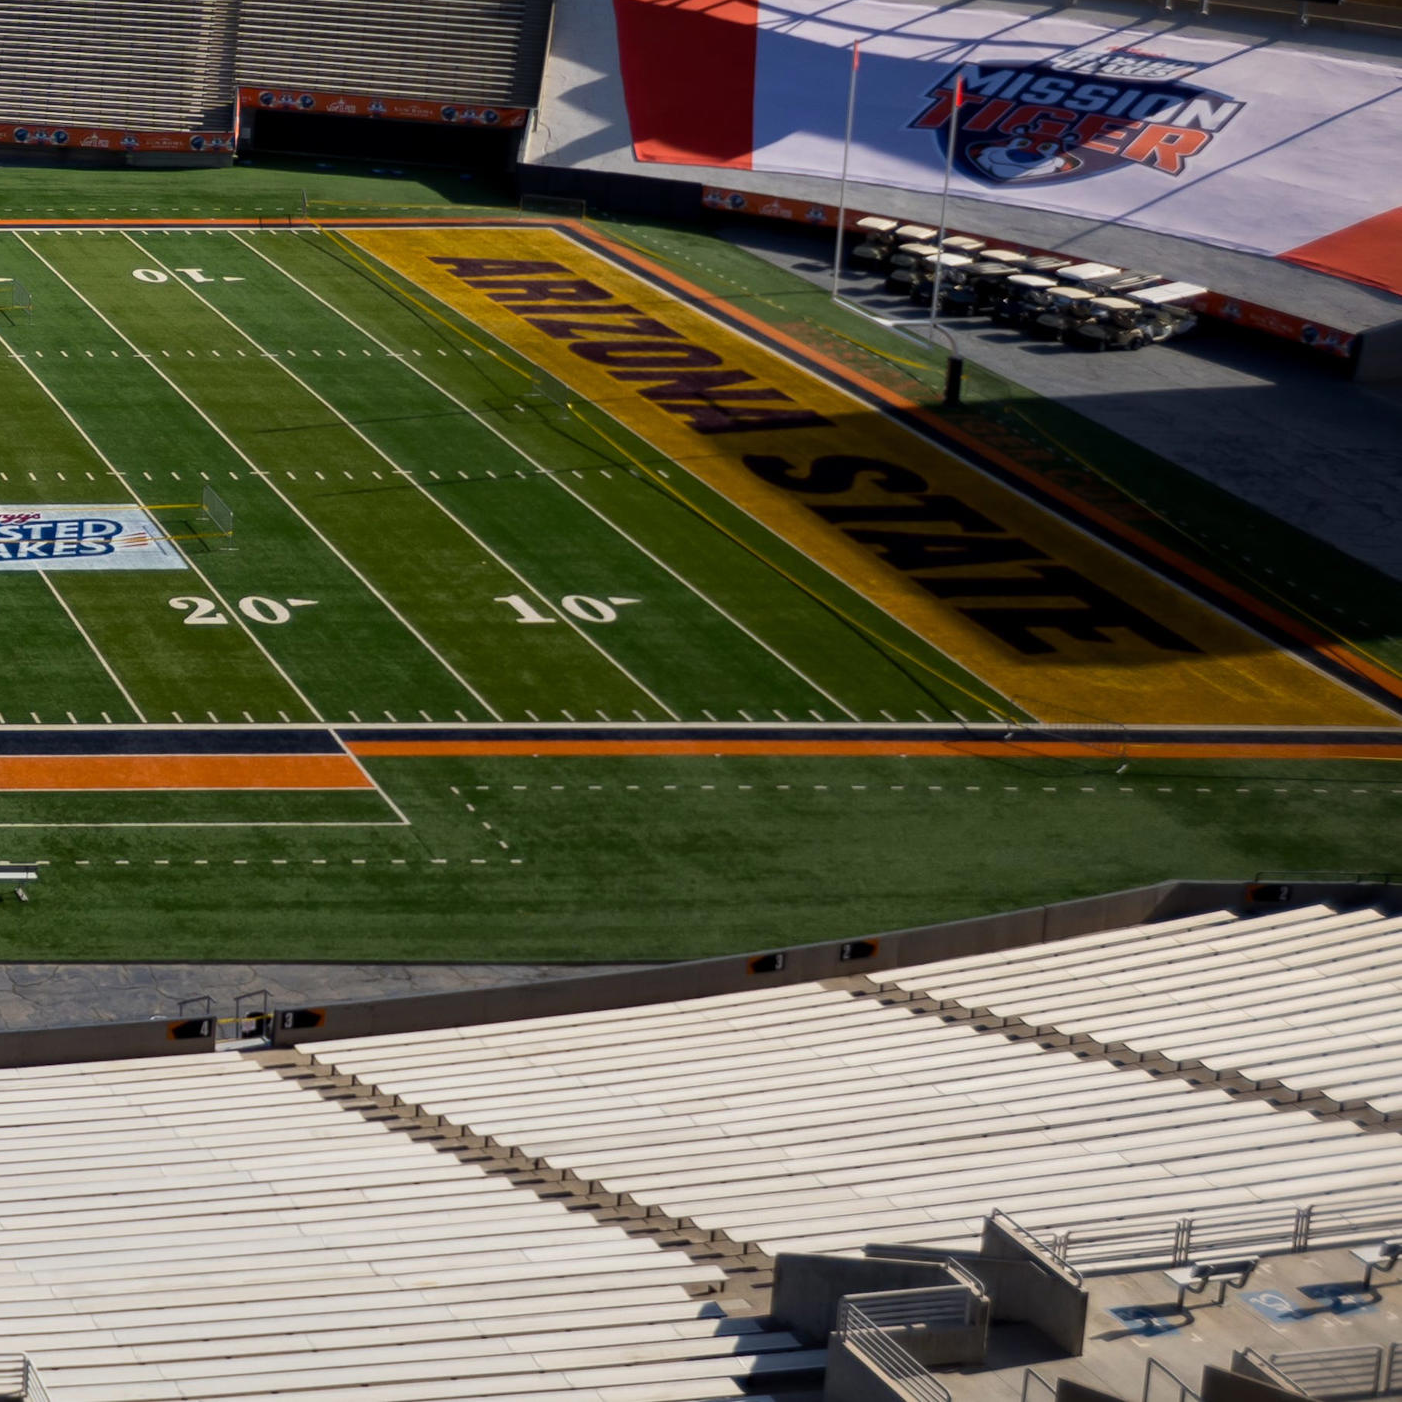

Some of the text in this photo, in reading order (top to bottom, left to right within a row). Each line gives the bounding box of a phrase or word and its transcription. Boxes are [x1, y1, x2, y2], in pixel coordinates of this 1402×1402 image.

[943, 64, 1242, 130] MISSION
[915, 89, 1211, 174] TIGER
[131, 267, 221, 284] 10
[426, 255, 837, 436] ARIZONA
[742, 453, 1207, 657] STATE
[167, 595, 292, 625] 20
[493, 594, 620, 624] 10
[1279, 886, 1288, 901] 2
[775, 954, 783, 970] 3
[843, 944, 851, 959] 2
[199, 1020, 209, 1036] 4
[284, 1012, 294, 1028] 3
